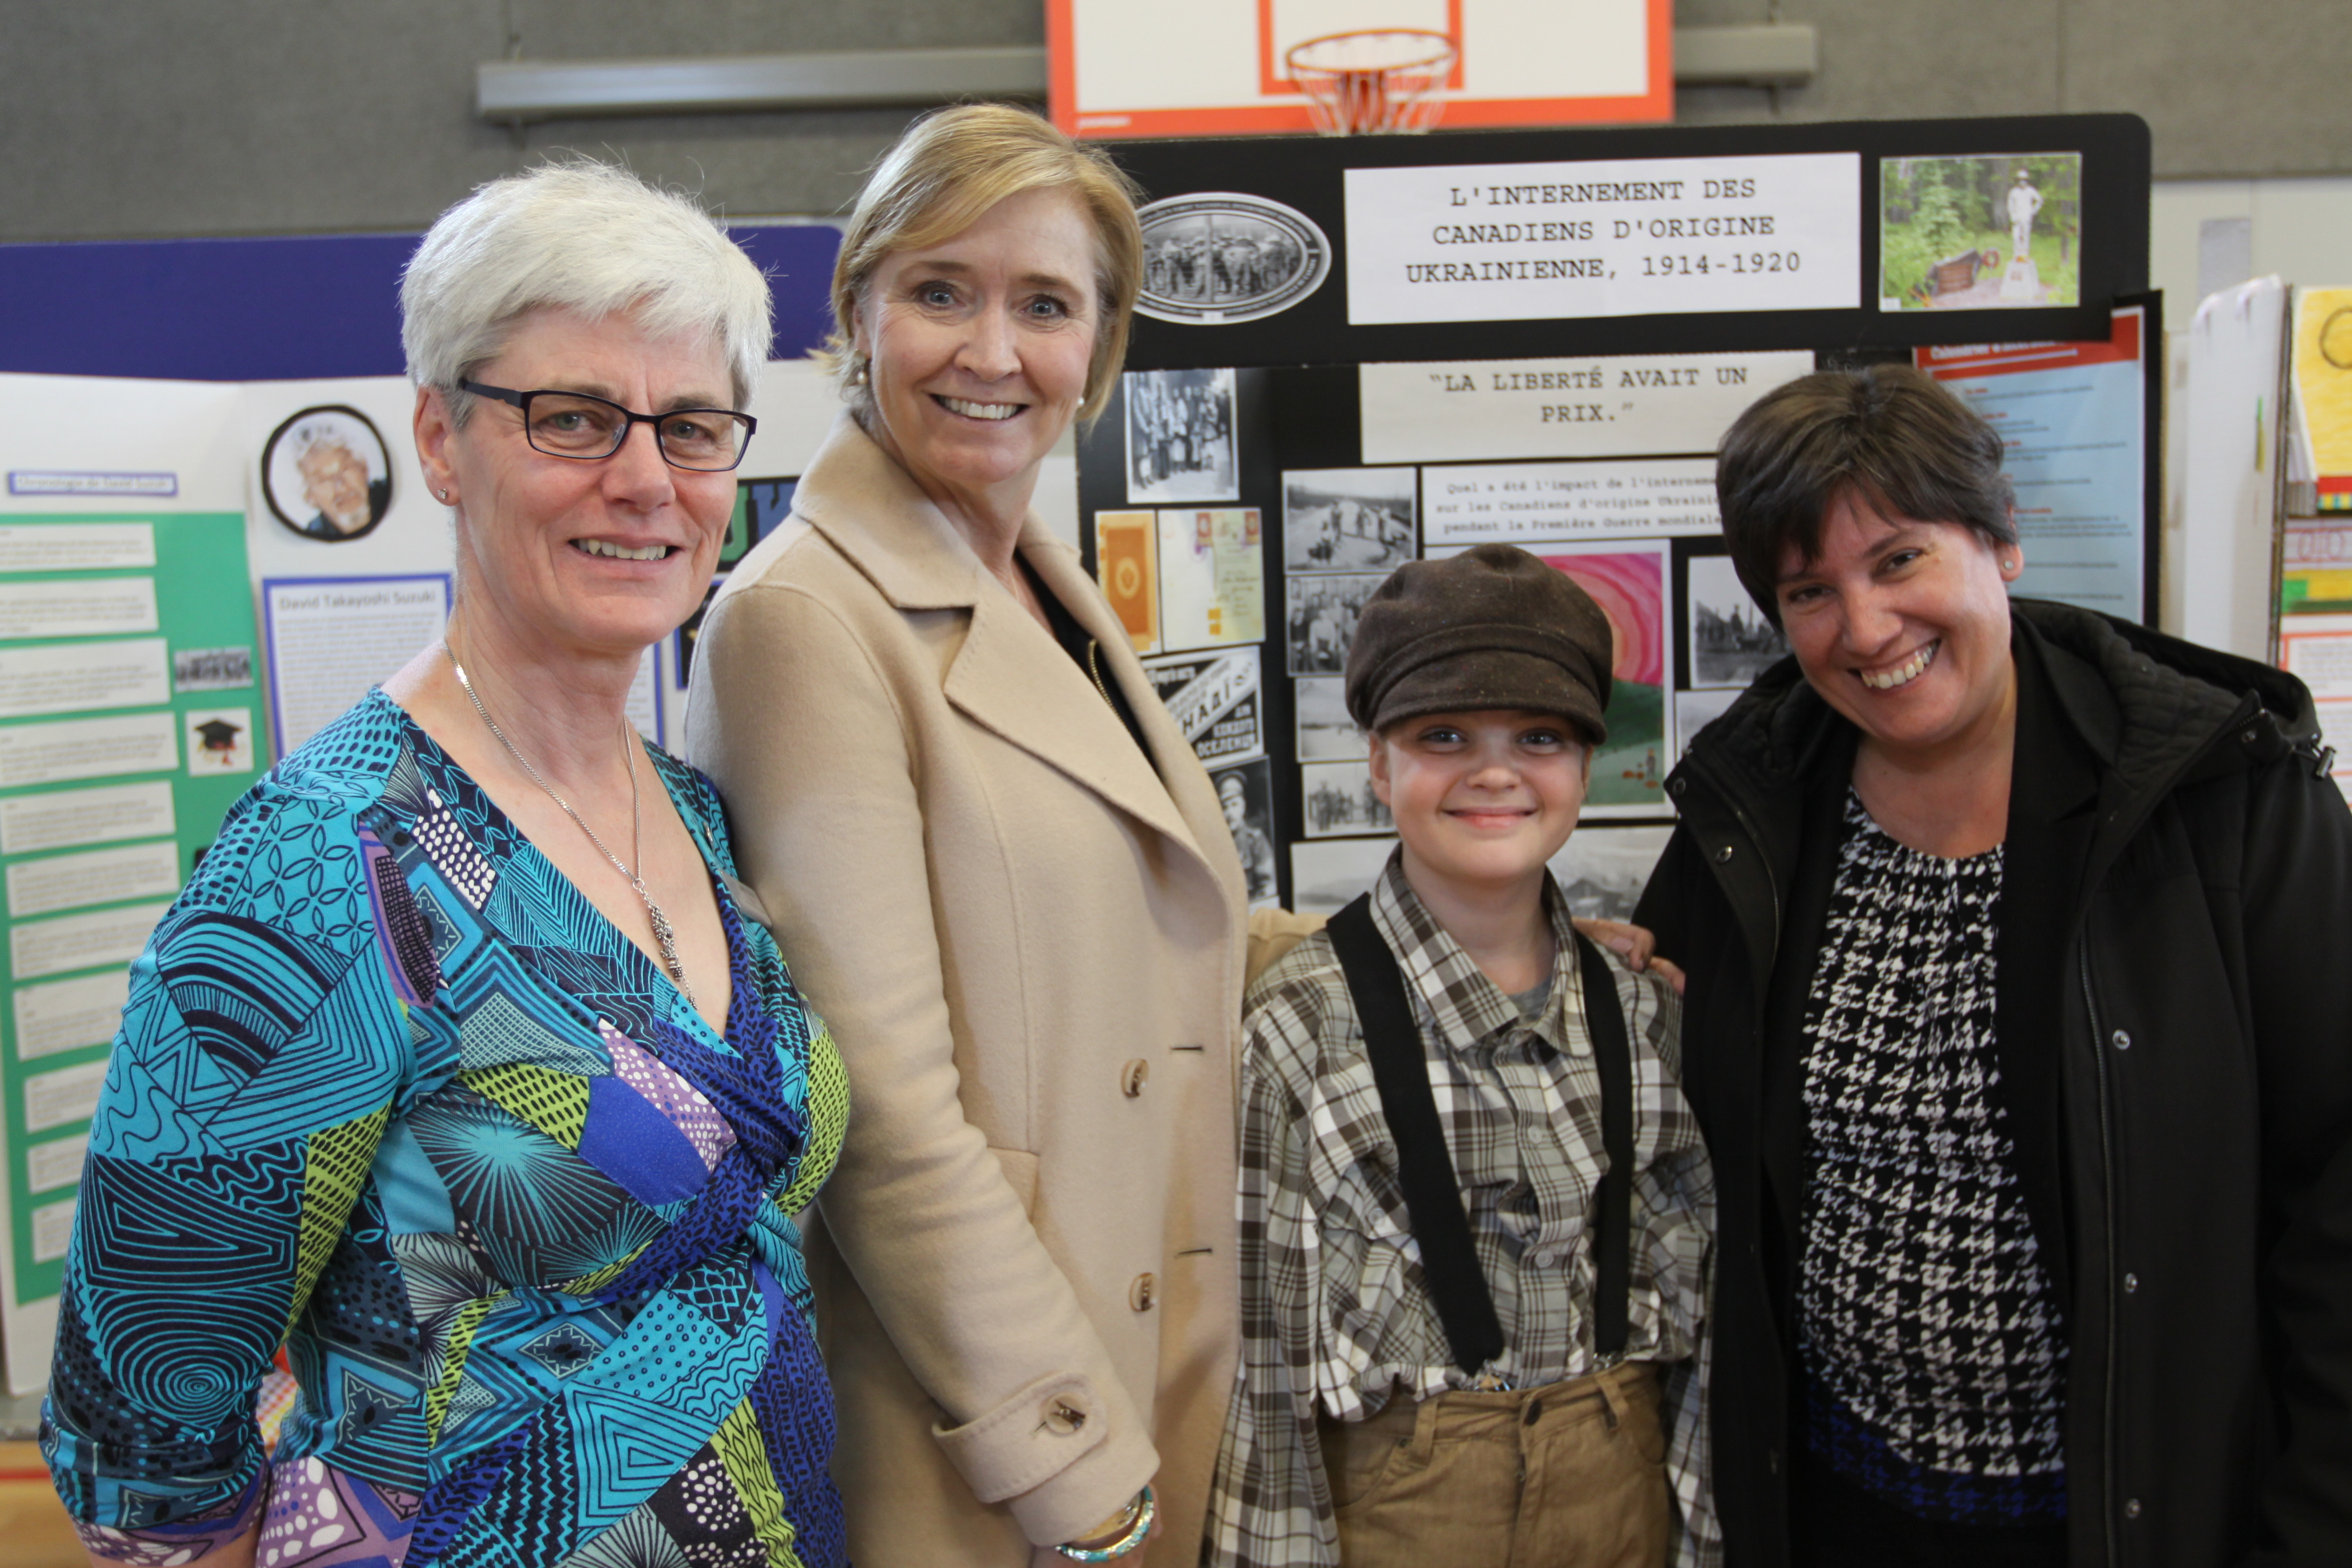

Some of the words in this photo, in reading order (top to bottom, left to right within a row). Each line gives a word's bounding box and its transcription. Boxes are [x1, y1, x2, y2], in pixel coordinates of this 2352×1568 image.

[1451, 181, 1684, 207] L'INTERNEMENT
[1703, 178, 1756, 200] DES
[1433, 221, 1594, 245] CANADIENS
[1614, 216, 1775, 240] D'ORIGINE
[1406, 258, 1616, 284] UKRAINIENNE,
[1643, 251, 1801, 277] 1914-1920
[1493, 366, 1604, 392] LIBERTÉ
[1619, 369, 1700, 388] AVAIT
[1716, 367, 1748, 386] UN
[1447, 482, 1478, 495] Quel
[1487, 485, 1495, 493] a
[1536, 479, 1599, 493] l'impact
[1607, 478, 1623, 490] de
[1436, 504, 1460, 513] sur
[1469, 502, 1492, 513] les
[1499, 500, 1571, 512] Canadiens
[1579, 497, 1652, 511] d'origine
[1444, 522, 1500, 535] pendant
[1509, 520, 1525, 532] la
[1603, 517, 1651, 529] Guerre
[280, 595, 320, 610] David
